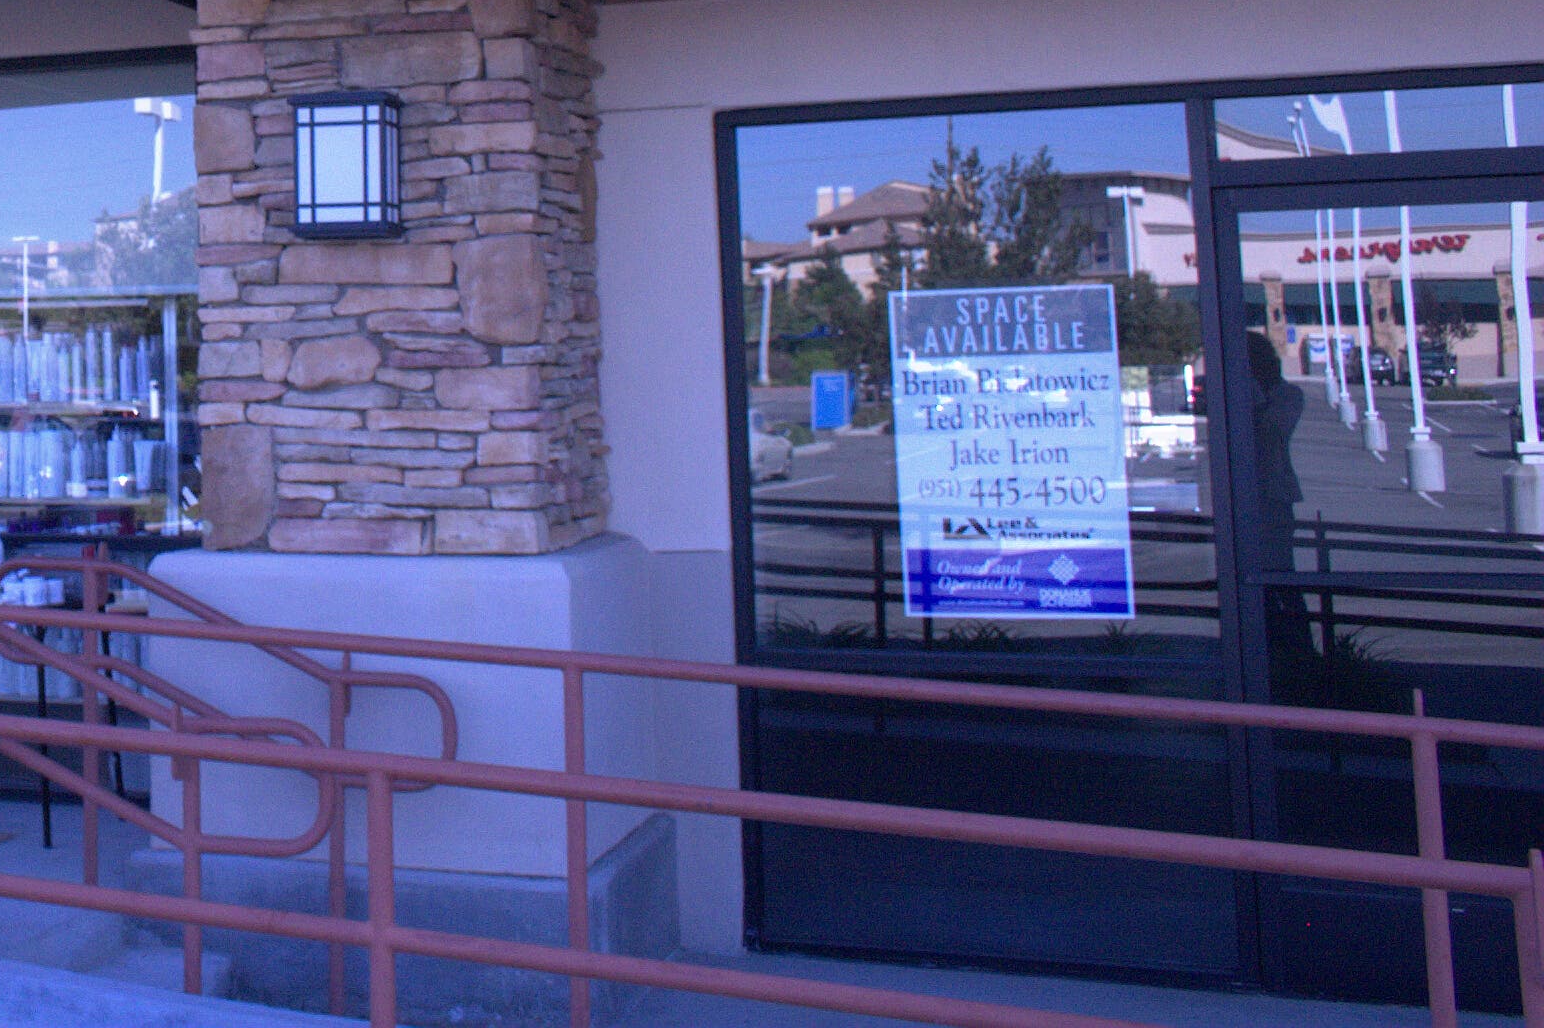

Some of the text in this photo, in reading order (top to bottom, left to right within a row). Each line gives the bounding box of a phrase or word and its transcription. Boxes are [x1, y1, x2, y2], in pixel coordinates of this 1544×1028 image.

[956, 294, 1047, 325] SPACE
[923, 322, 1085, 354] AVAILABLE
[902, 370, 967, 397] Brian
[920, 400, 1096, 431] Ted Rivenbark
[949, 438, 1070, 471] Jake Irion
[917, 475, 1106, 507] (951) 445-4500
[987, 517, 1022, 530] Lee
[938, 574, 1025, 595] Operated by
